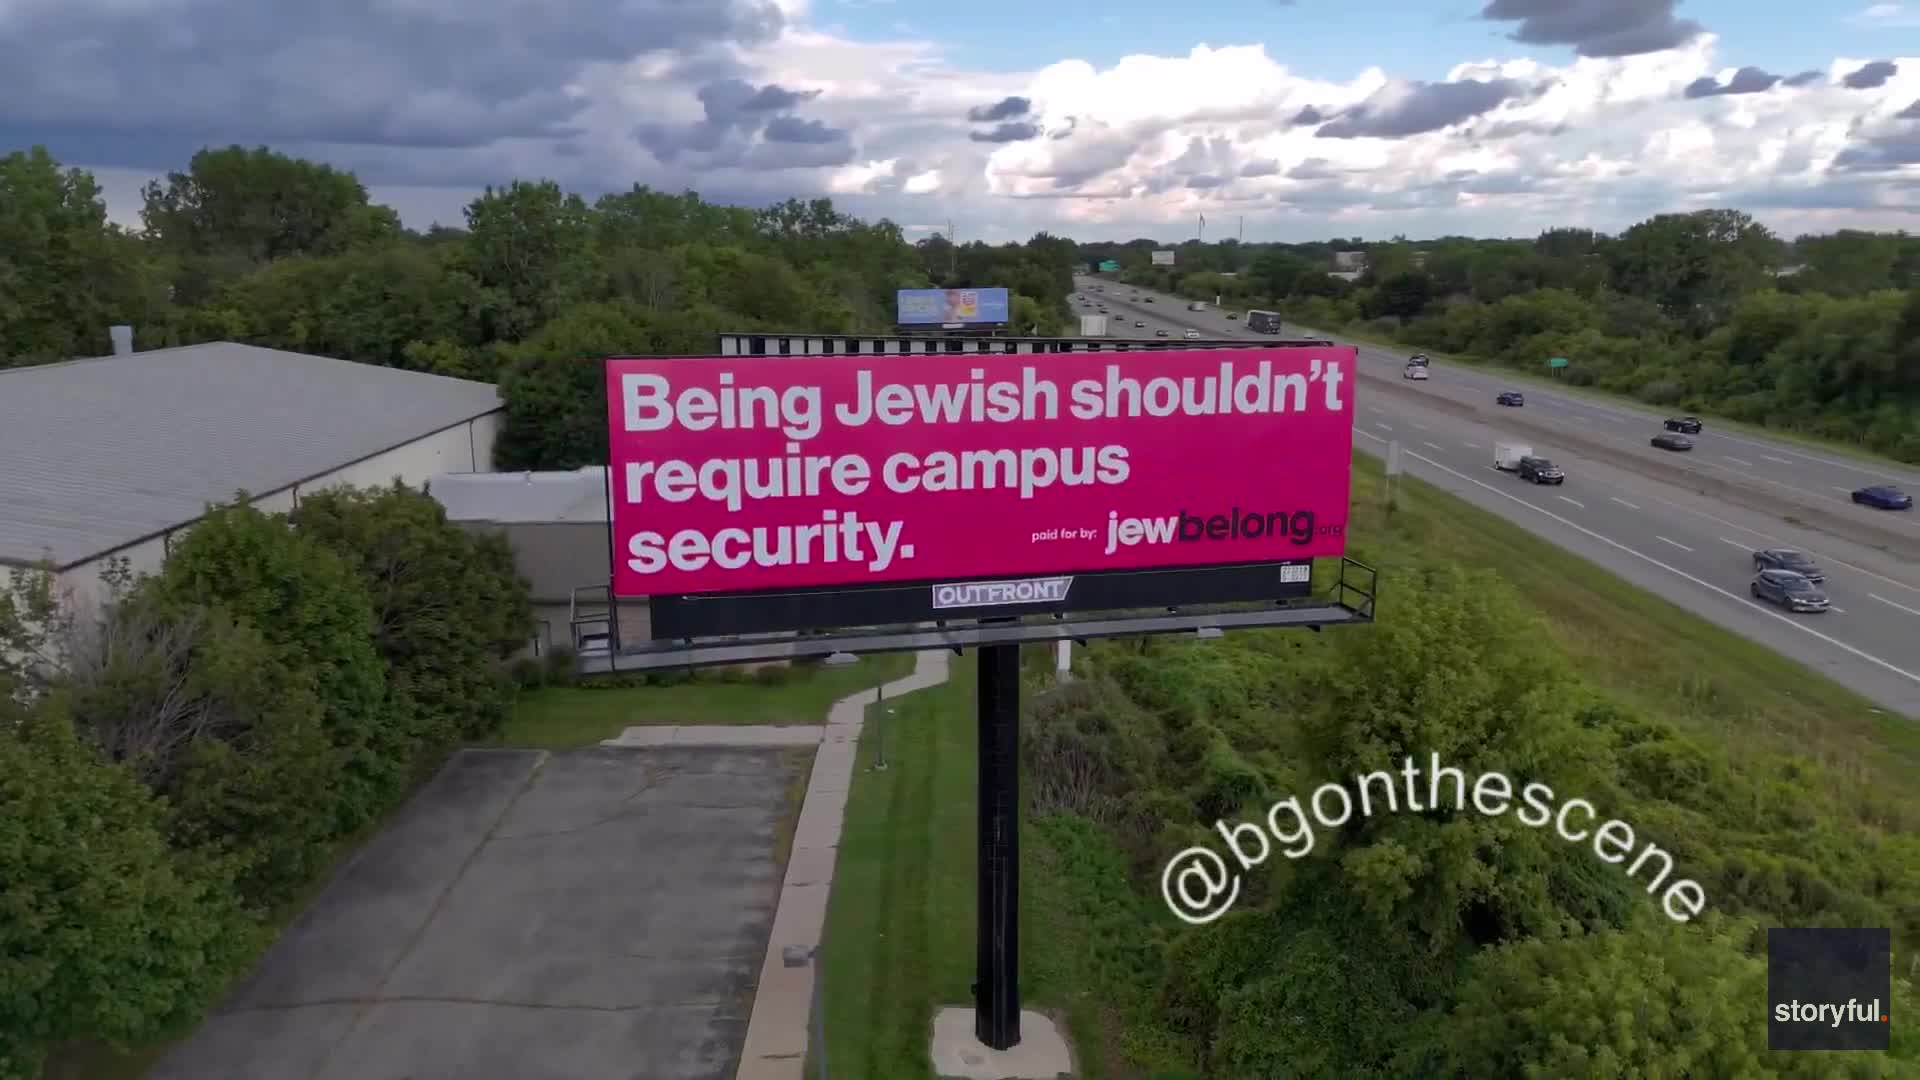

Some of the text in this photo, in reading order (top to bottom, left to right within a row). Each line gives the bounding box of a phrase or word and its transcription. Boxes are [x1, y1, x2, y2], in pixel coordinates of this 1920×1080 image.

[622, 360, 1343, 439] Being Jewish shouldn't
[626, 442, 1131, 511] require campus
[628, 510, 914, 573] security.
[1031, 529, 1059, 544] paid
[1061, 528, 1078, 540] for
[1080, 527, 1098, 541] by:
[938, 580, 1065, 606] OUTFRONT
